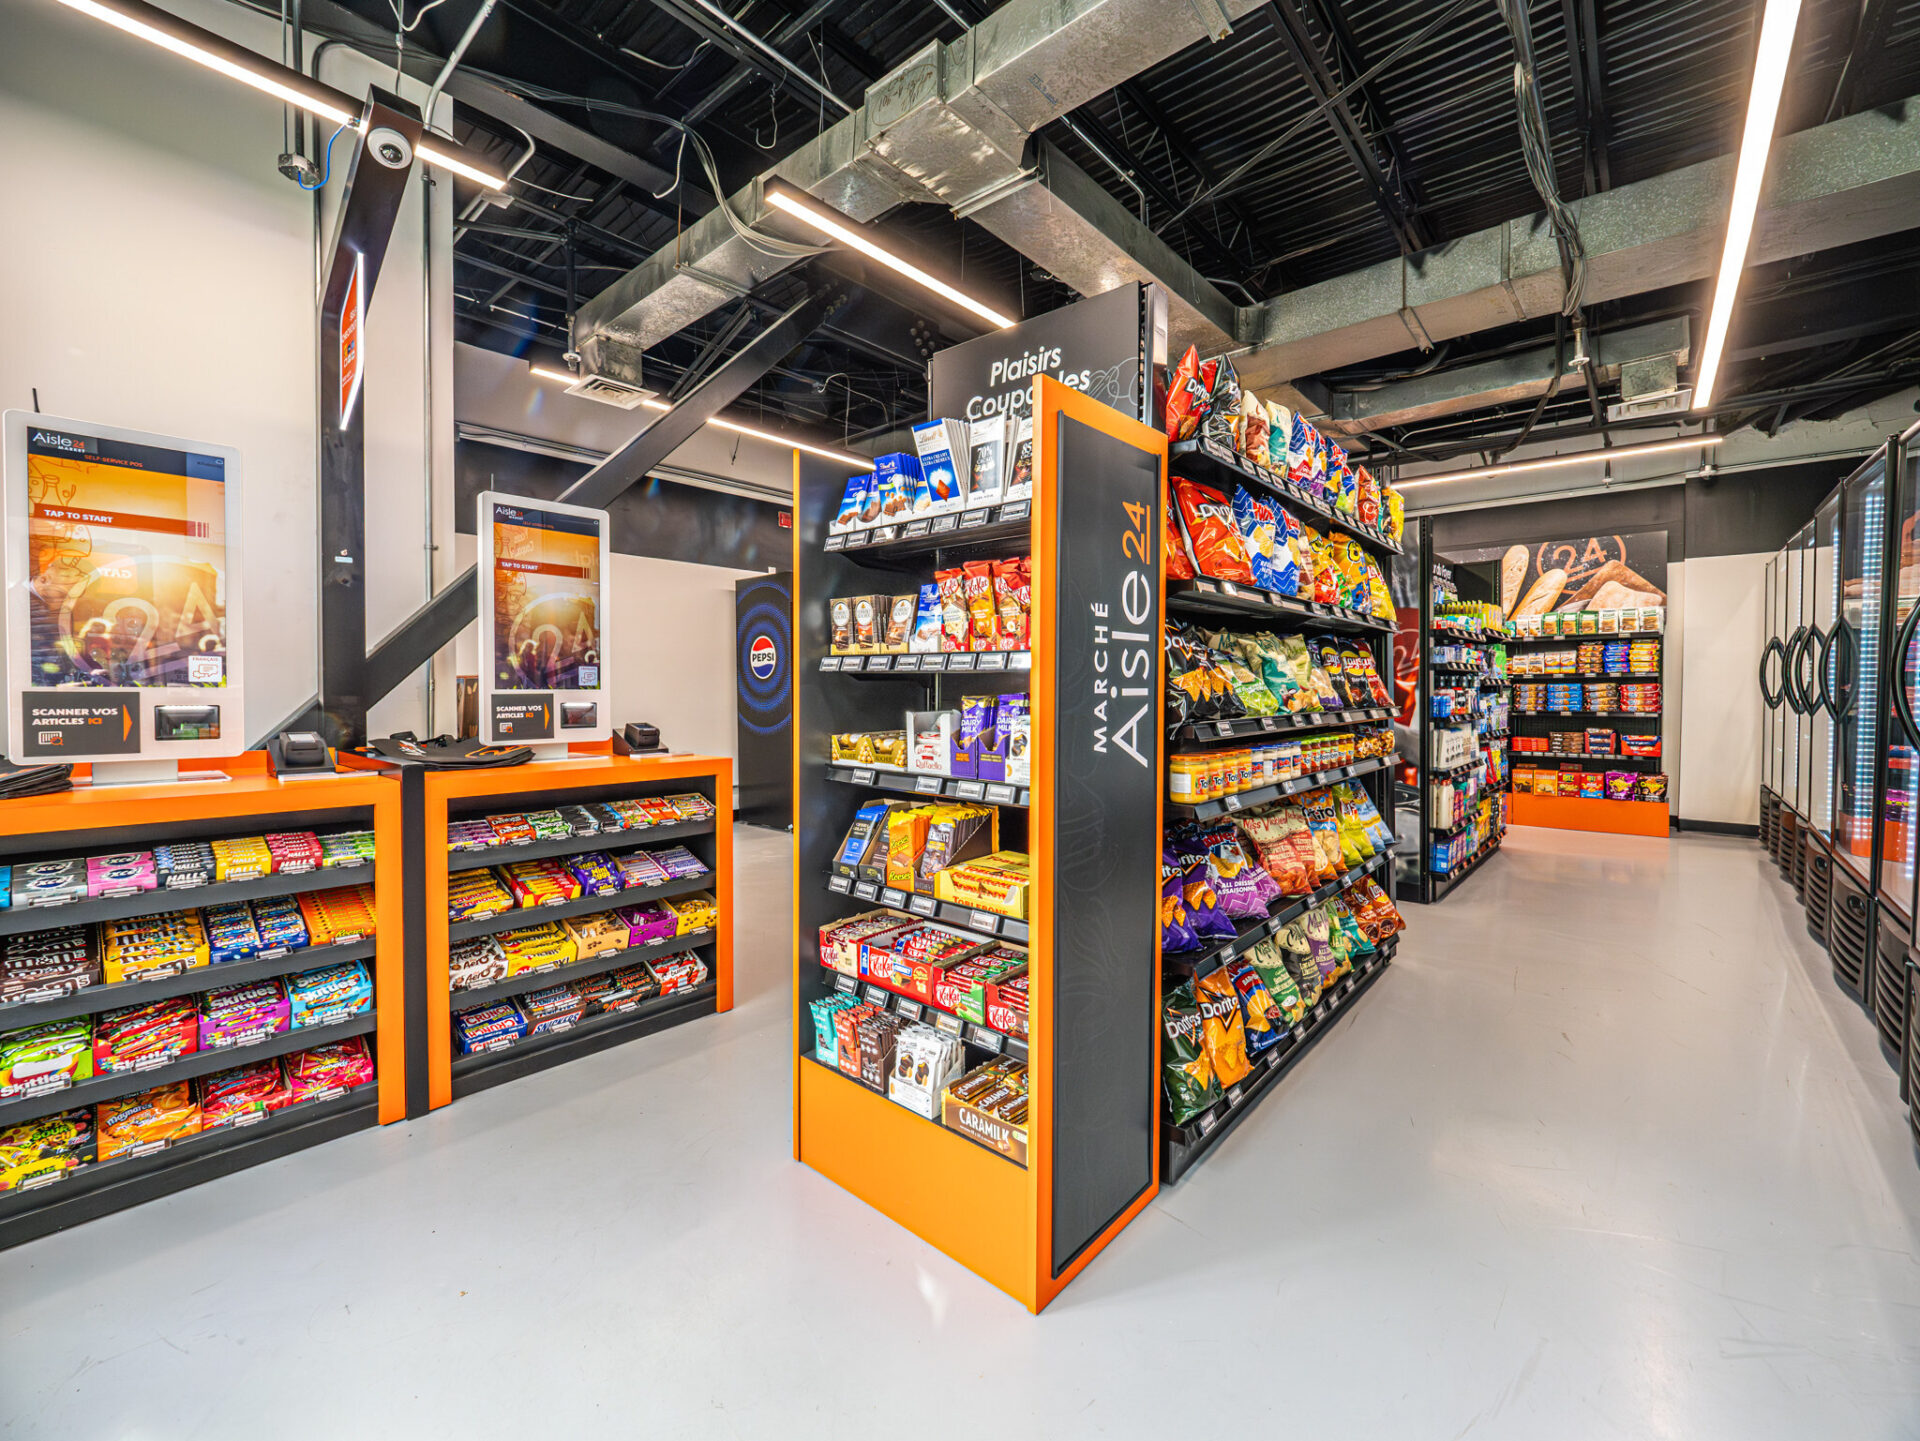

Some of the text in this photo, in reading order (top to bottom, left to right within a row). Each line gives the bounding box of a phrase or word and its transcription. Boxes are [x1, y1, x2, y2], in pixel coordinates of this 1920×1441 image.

[990, 346, 1062, 387] Plaisirs
[32, 431, 72, 448] Aisle
[43, 509, 114, 523] TAP TO START
[495, 506, 517, 517] Aisle
[1111, 500, 1151, 768] Aisle 24
[752, 652, 775, 663] PEPSI
[1090, 602, 1109, 753] MARCHÉ
[32, 708, 89, 716] SCANNER
[32, 717, 103, 726] ARTICLES ICI
[174, 862, 202, 870] HALLS
[225, 865, 262, 876] HALLS
[280, 858, 315, 868] HALLS
[166, 871, 208, 883] HALLS
[1221, 881, 1233, 889] ALL
[297, 965, 355, 987] Skittles
[873, 956, 893, 976] KitKat
[211, 985, 277, 1008] Skittles
[298, 977, 357, 1001] Skittles
[940, 987, 961, 1007] KitKat
[465, 1004, 512, 1025] CRUNCH
[536, 1013, 579, 1034] SNICKERS
[992, 1008, 1016, 1029] KitKat
[1165, 1011, 1202, 1040] Doritos
[111, 1048, 182, 1072] Skittles
[1, 1071, 71, 1097] Skittles
[106, 1103, 153, 1126] maynards
[32, 1126, 69, 1140] SOUR
[959, 1107, 1010, 1145] CARAMILK
